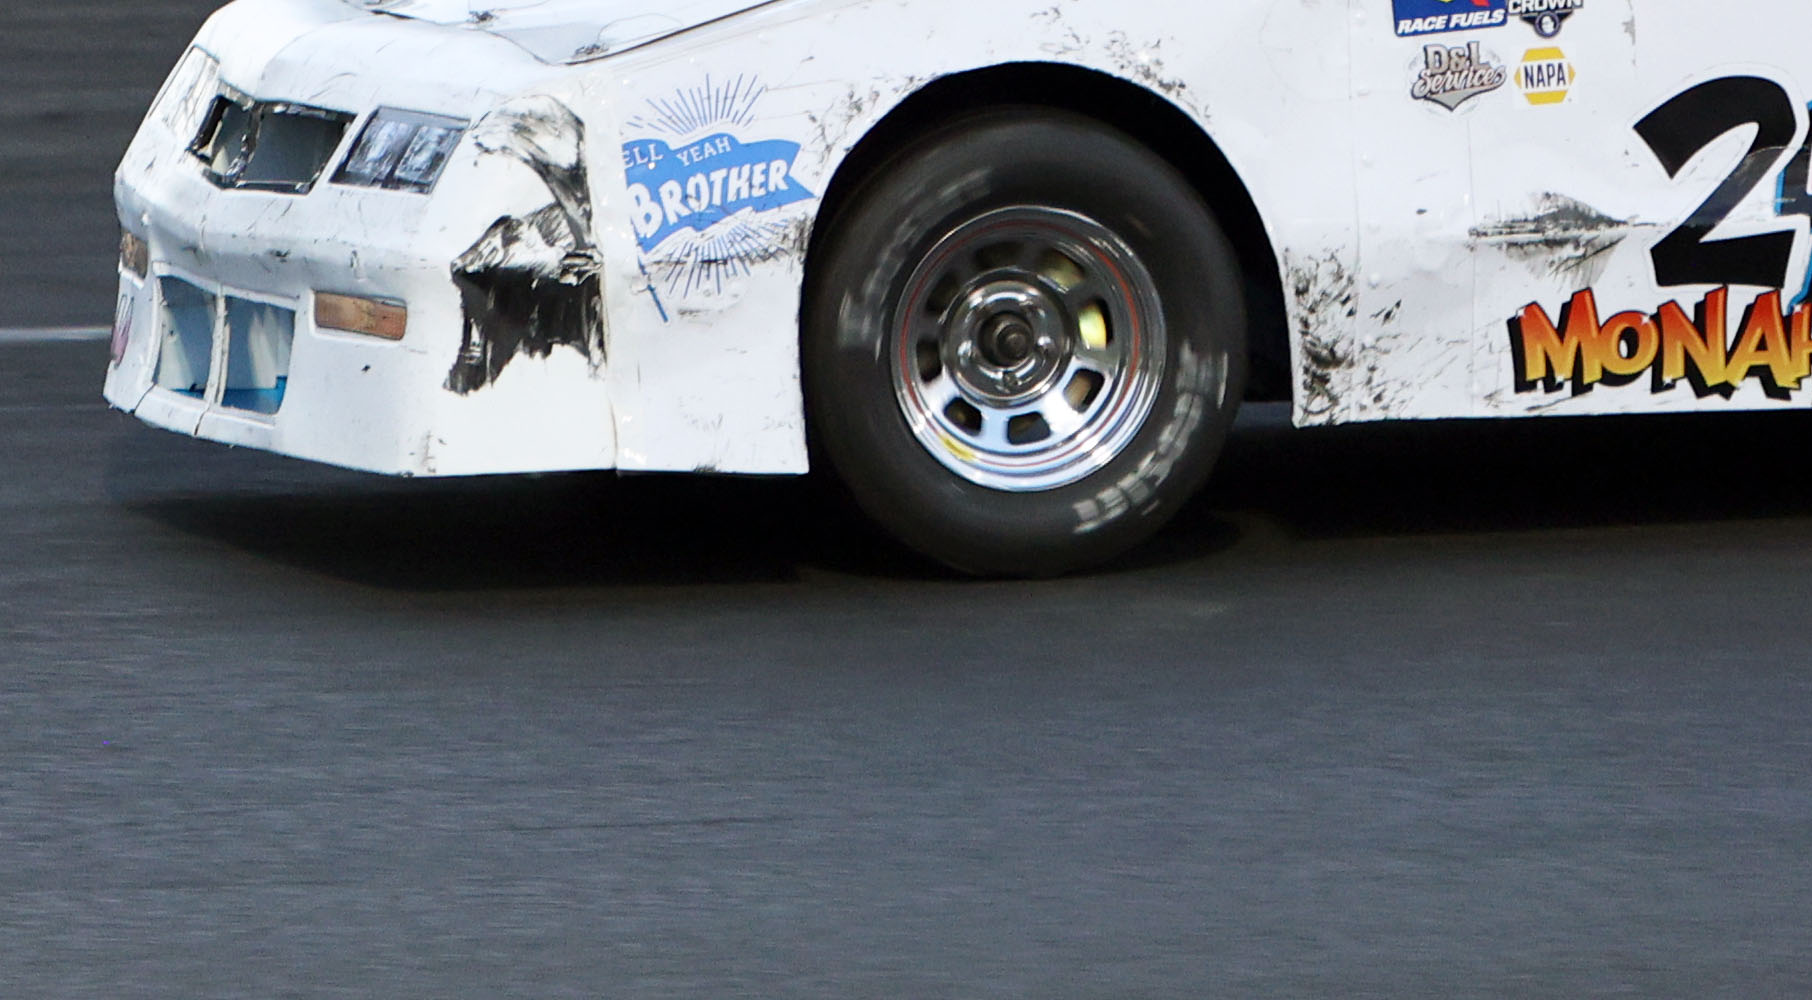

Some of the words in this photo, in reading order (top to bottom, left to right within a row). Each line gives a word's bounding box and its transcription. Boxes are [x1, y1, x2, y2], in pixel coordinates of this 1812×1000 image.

[1397, 15, 1449, 34] RACE
[1449, 8, 1506, 29] FUELS
[1424, 41, 1490, 76] D&L
[1411, 65, 1507, 100] Services
[1523, 62, 1567, 89] NAPA
[676, 135, 732, 167] YEAH
[625, 158, 790, 240] BROTHER
